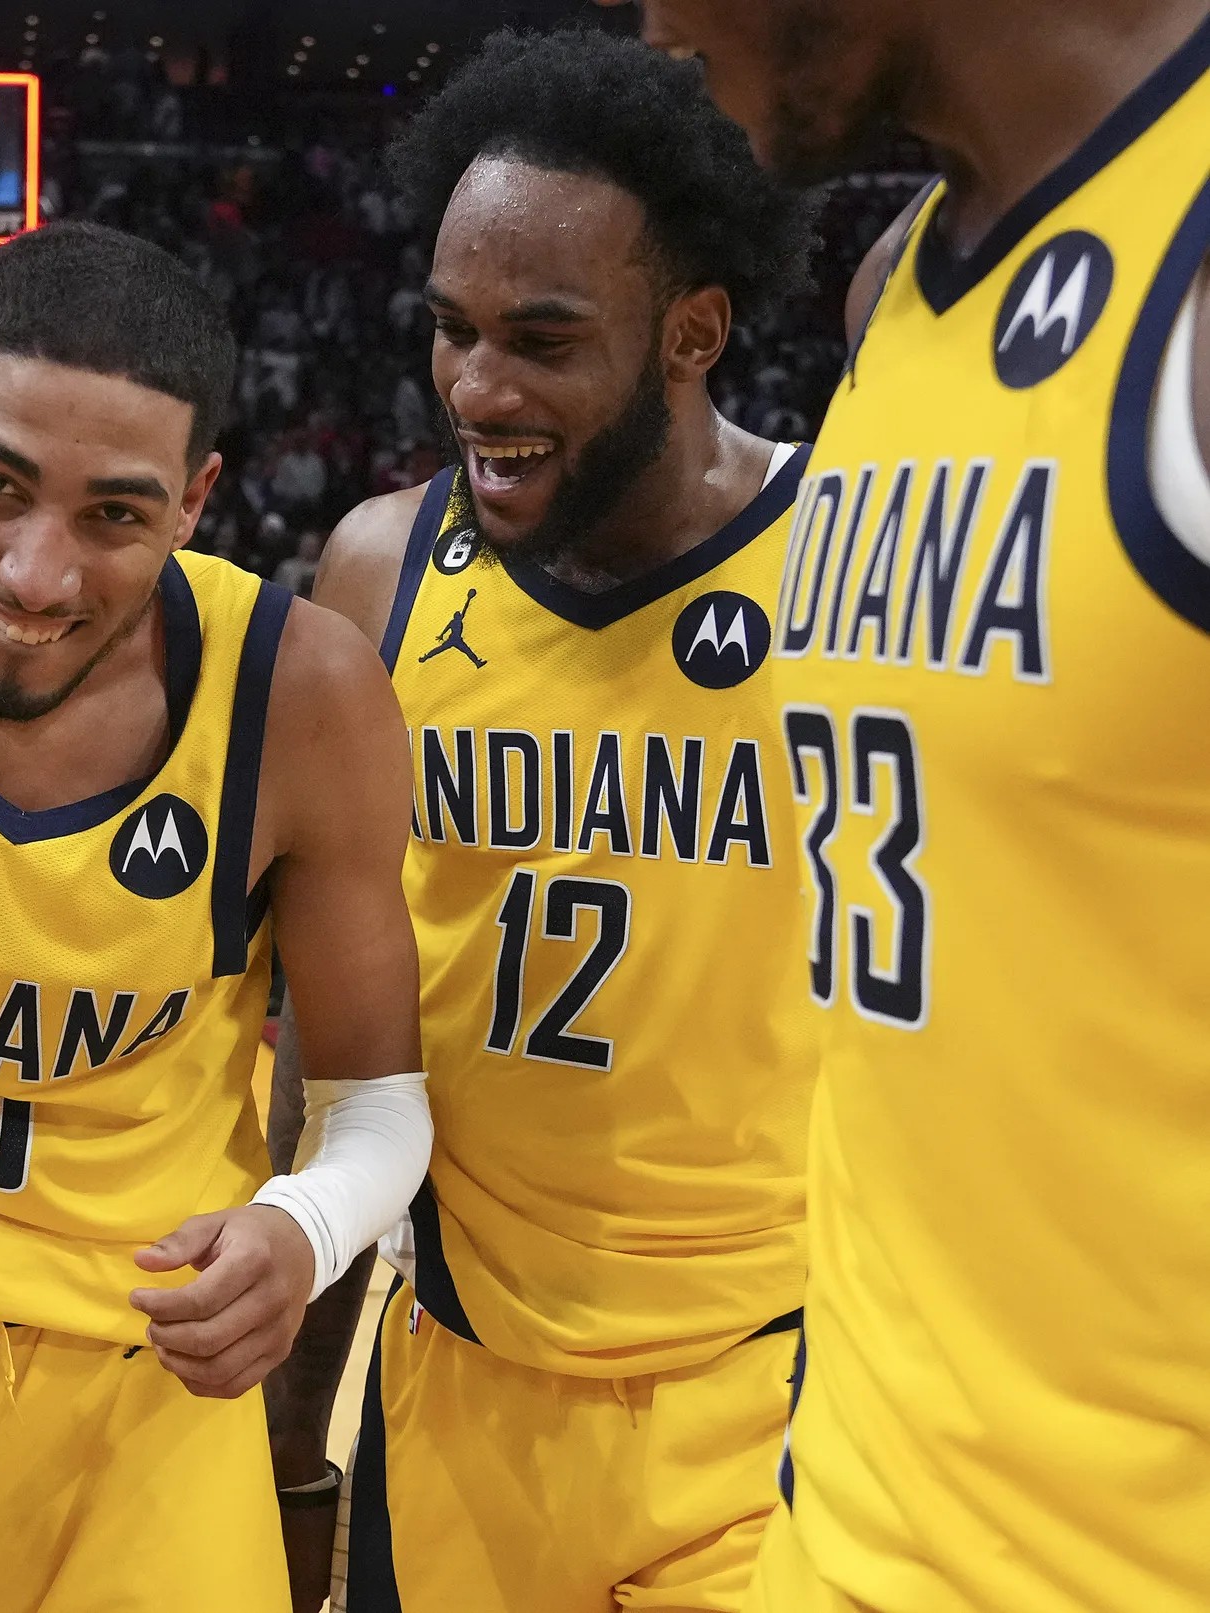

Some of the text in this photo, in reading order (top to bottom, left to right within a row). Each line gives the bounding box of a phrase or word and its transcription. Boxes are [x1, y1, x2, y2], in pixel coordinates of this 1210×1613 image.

[443, 528, 476, 567] 6
[782, 701, 933, 1032] 33
[483, 867, 633, 1072] 12
